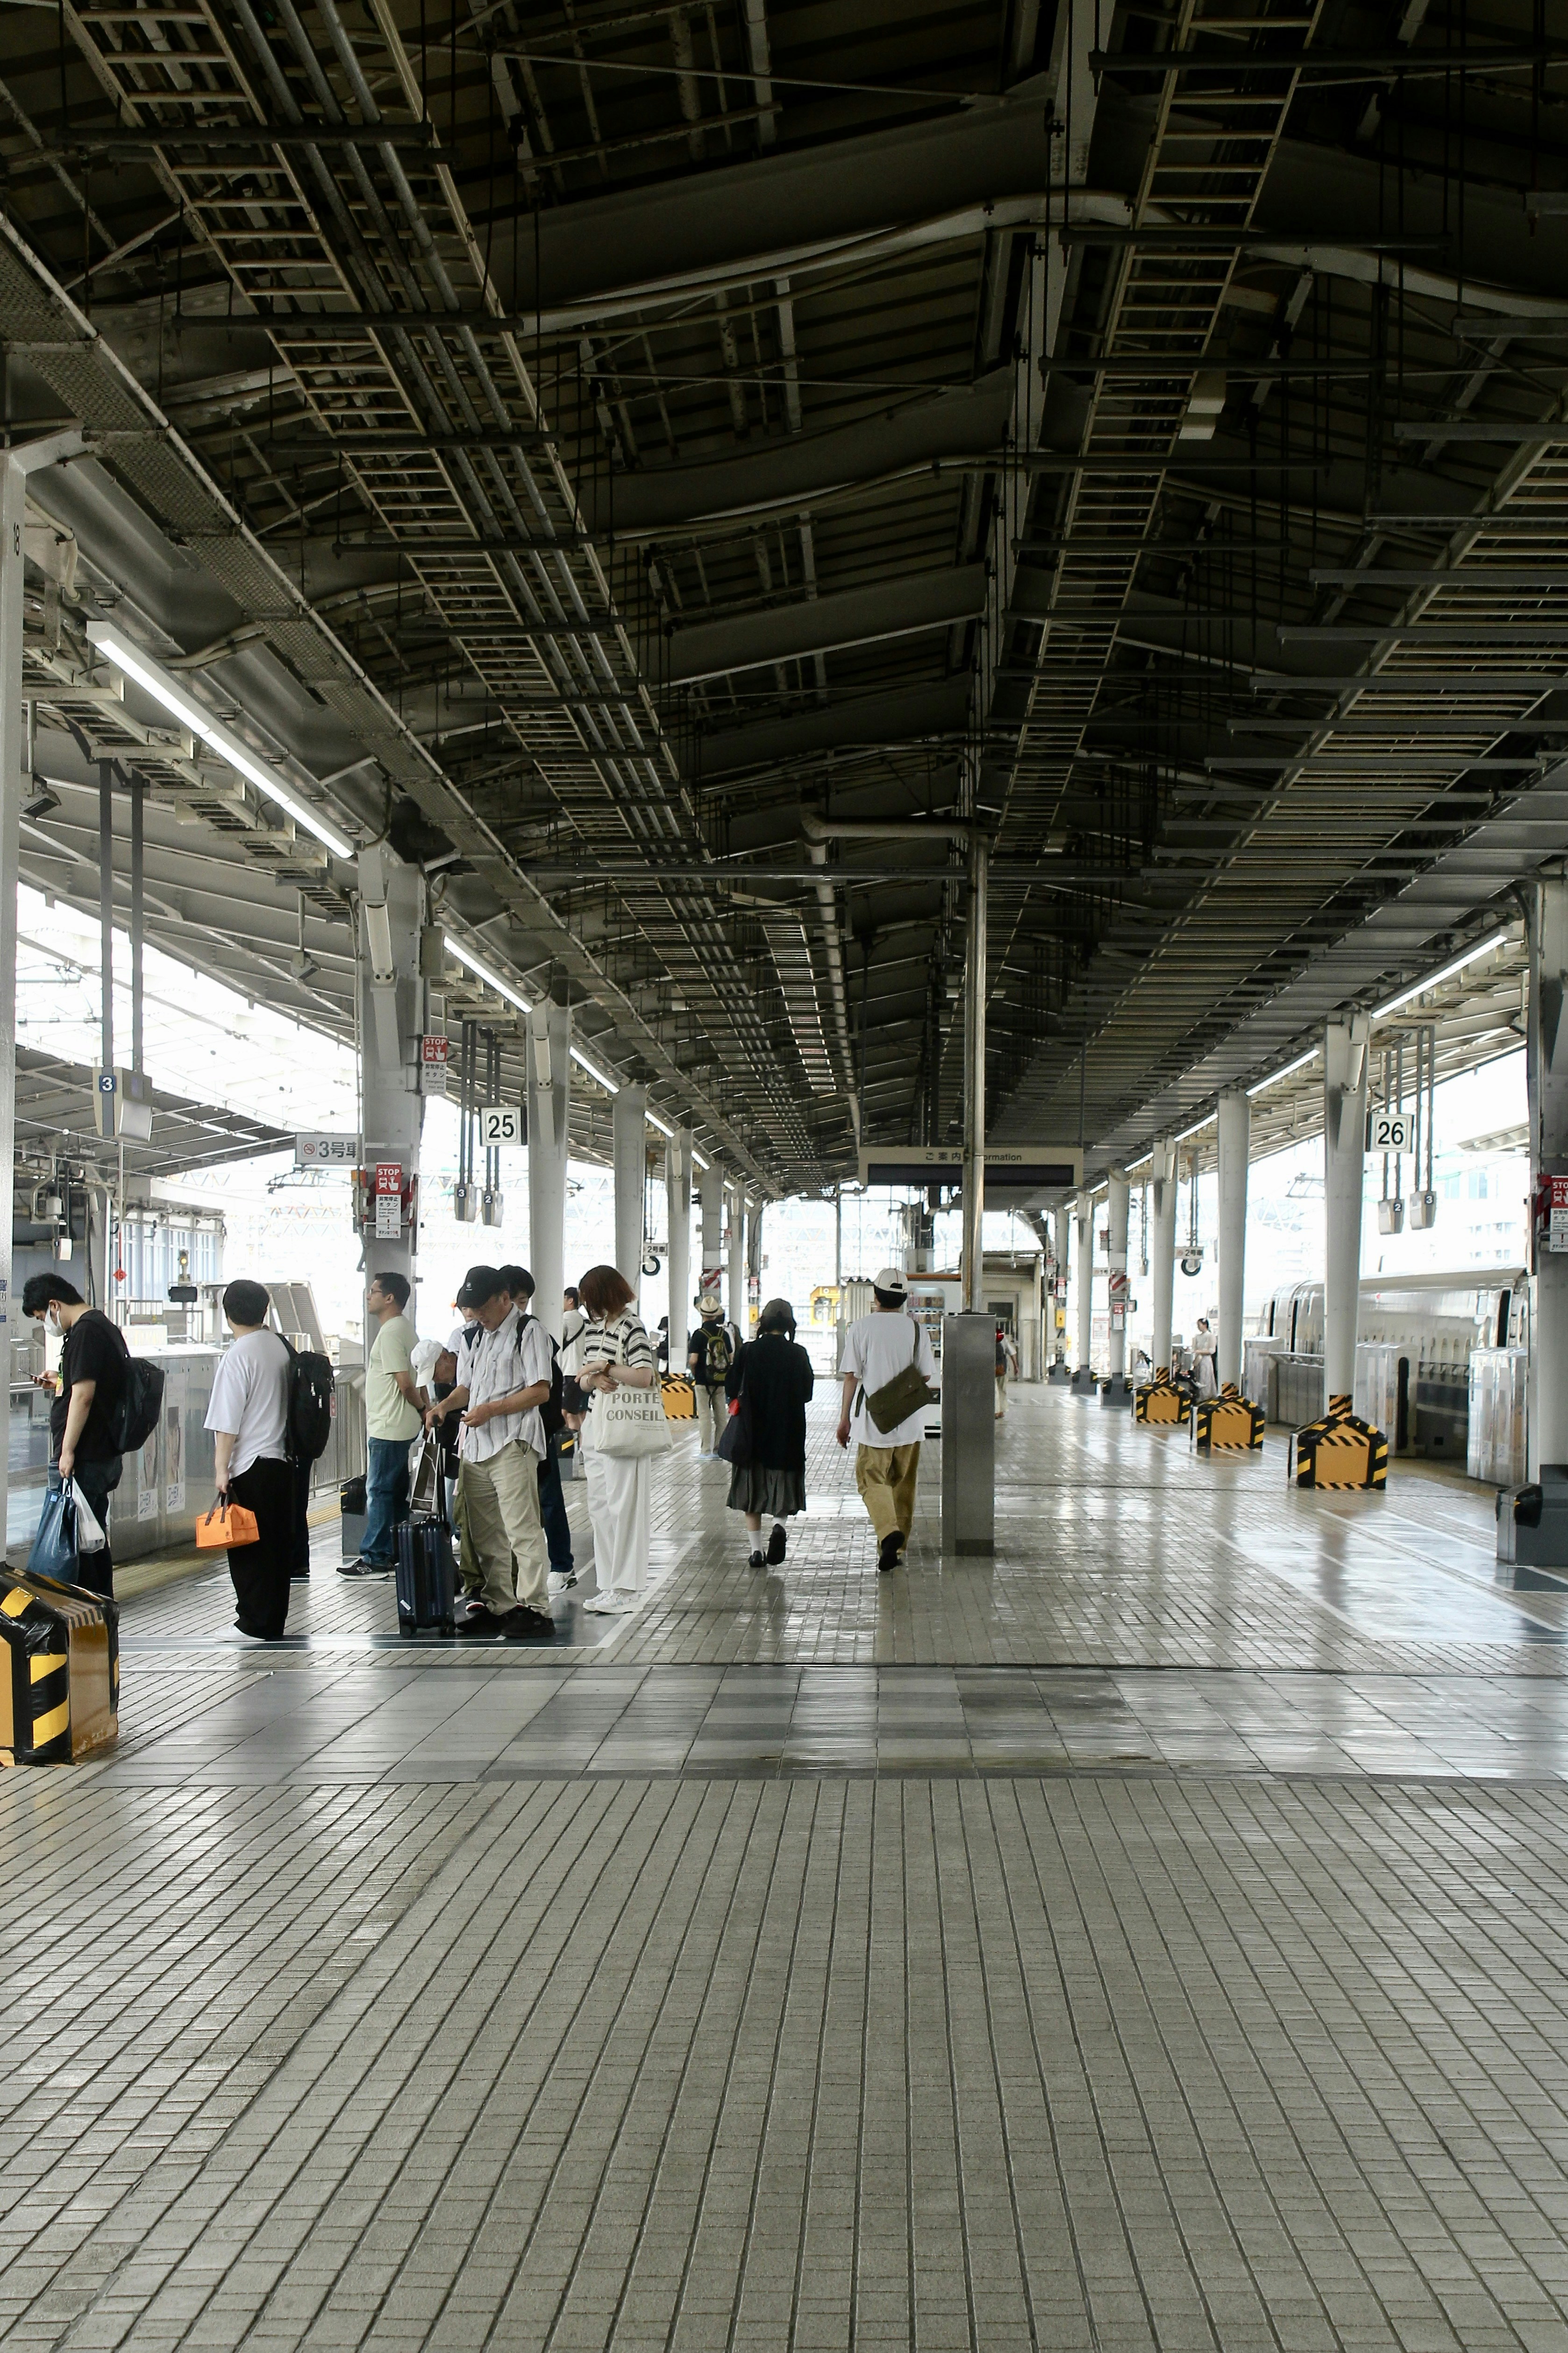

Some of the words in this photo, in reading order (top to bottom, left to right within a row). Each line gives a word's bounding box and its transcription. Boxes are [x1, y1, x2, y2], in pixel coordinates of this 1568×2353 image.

[13, 522, 20, 556] 18
[102, 1076, 114, 1091] 3
[488, 1115, 514, 1138] 25
[1377, 1121, 1404, 1145] 26
[925, 1152, 961, 1161] ご案内
[458, 1189, 465, 1197] 3
[485, 1195, 492, 1203] 2
[1425, 1195, 1433, 1204] 3
